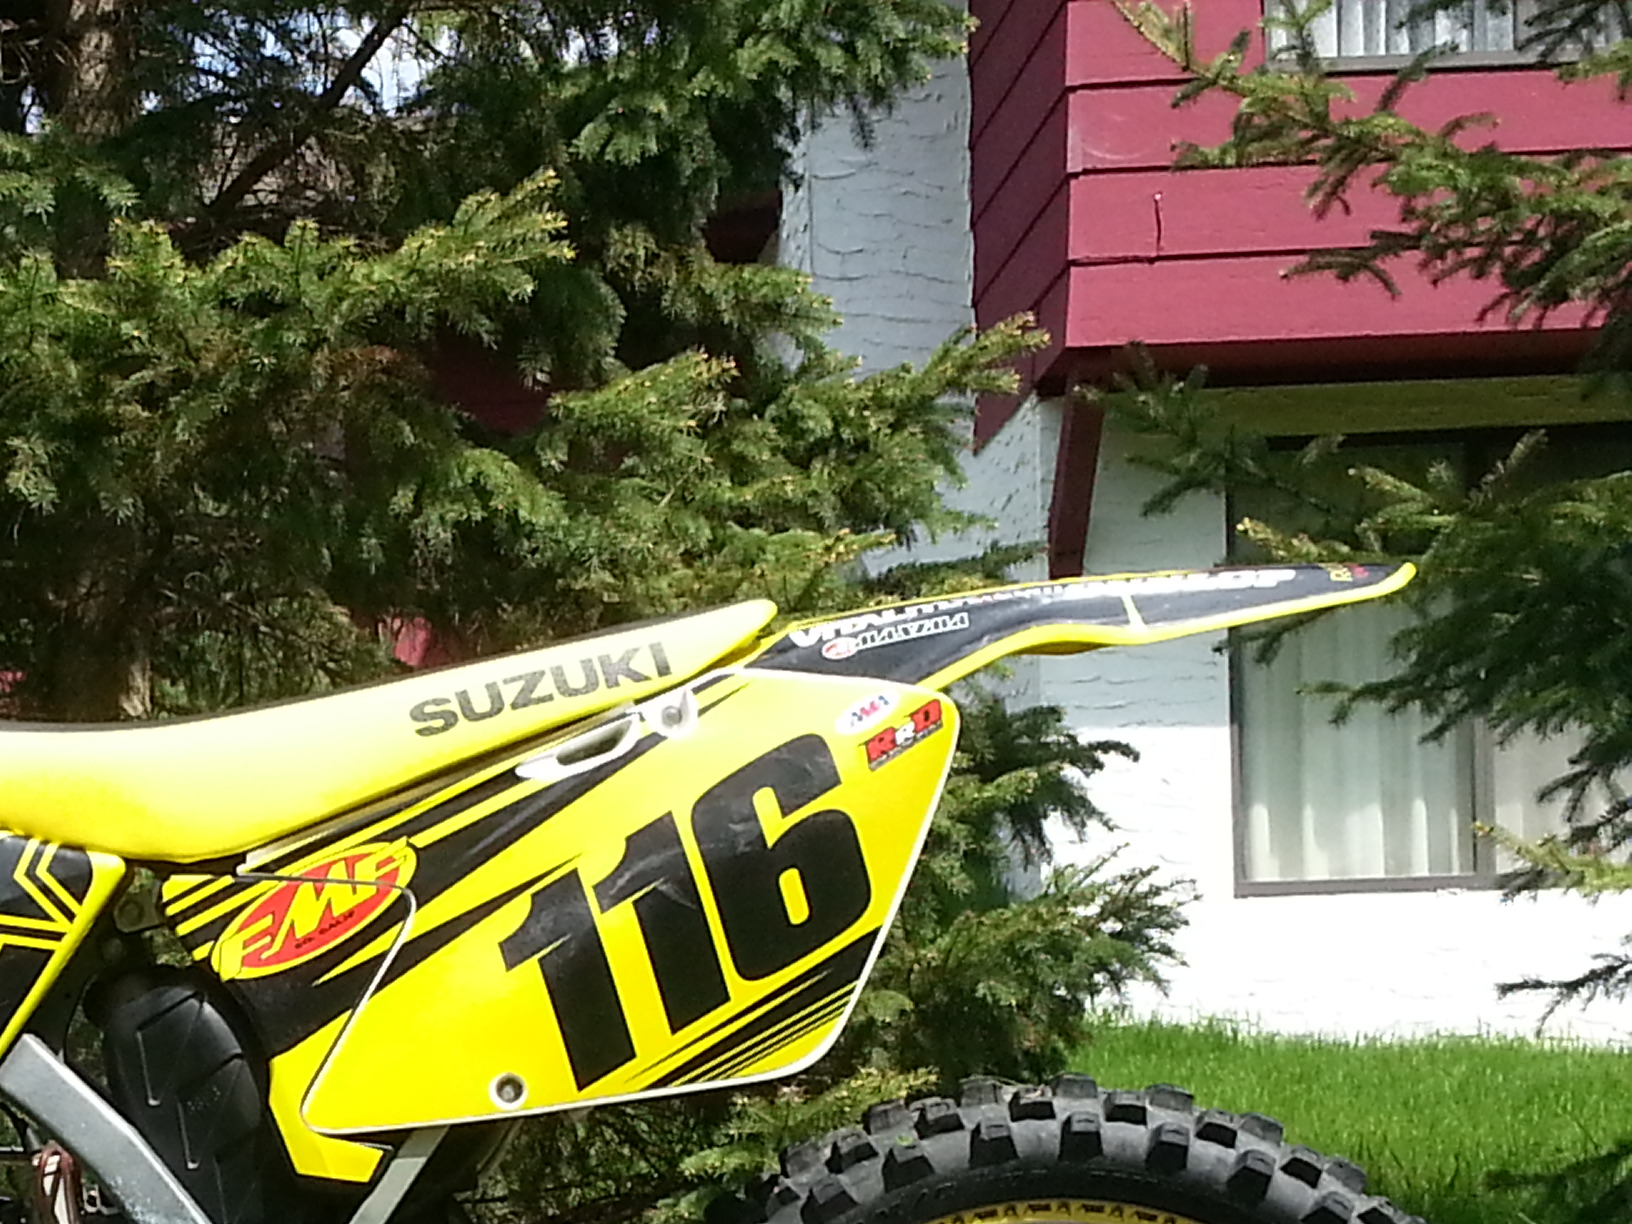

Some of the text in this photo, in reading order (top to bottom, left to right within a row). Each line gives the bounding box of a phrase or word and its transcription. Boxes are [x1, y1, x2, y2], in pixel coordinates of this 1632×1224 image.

[409, 641, 675, 737] SUZUKI
[219, 834, 410, 984] FMF
[499, 732, 873, 1092] 116
